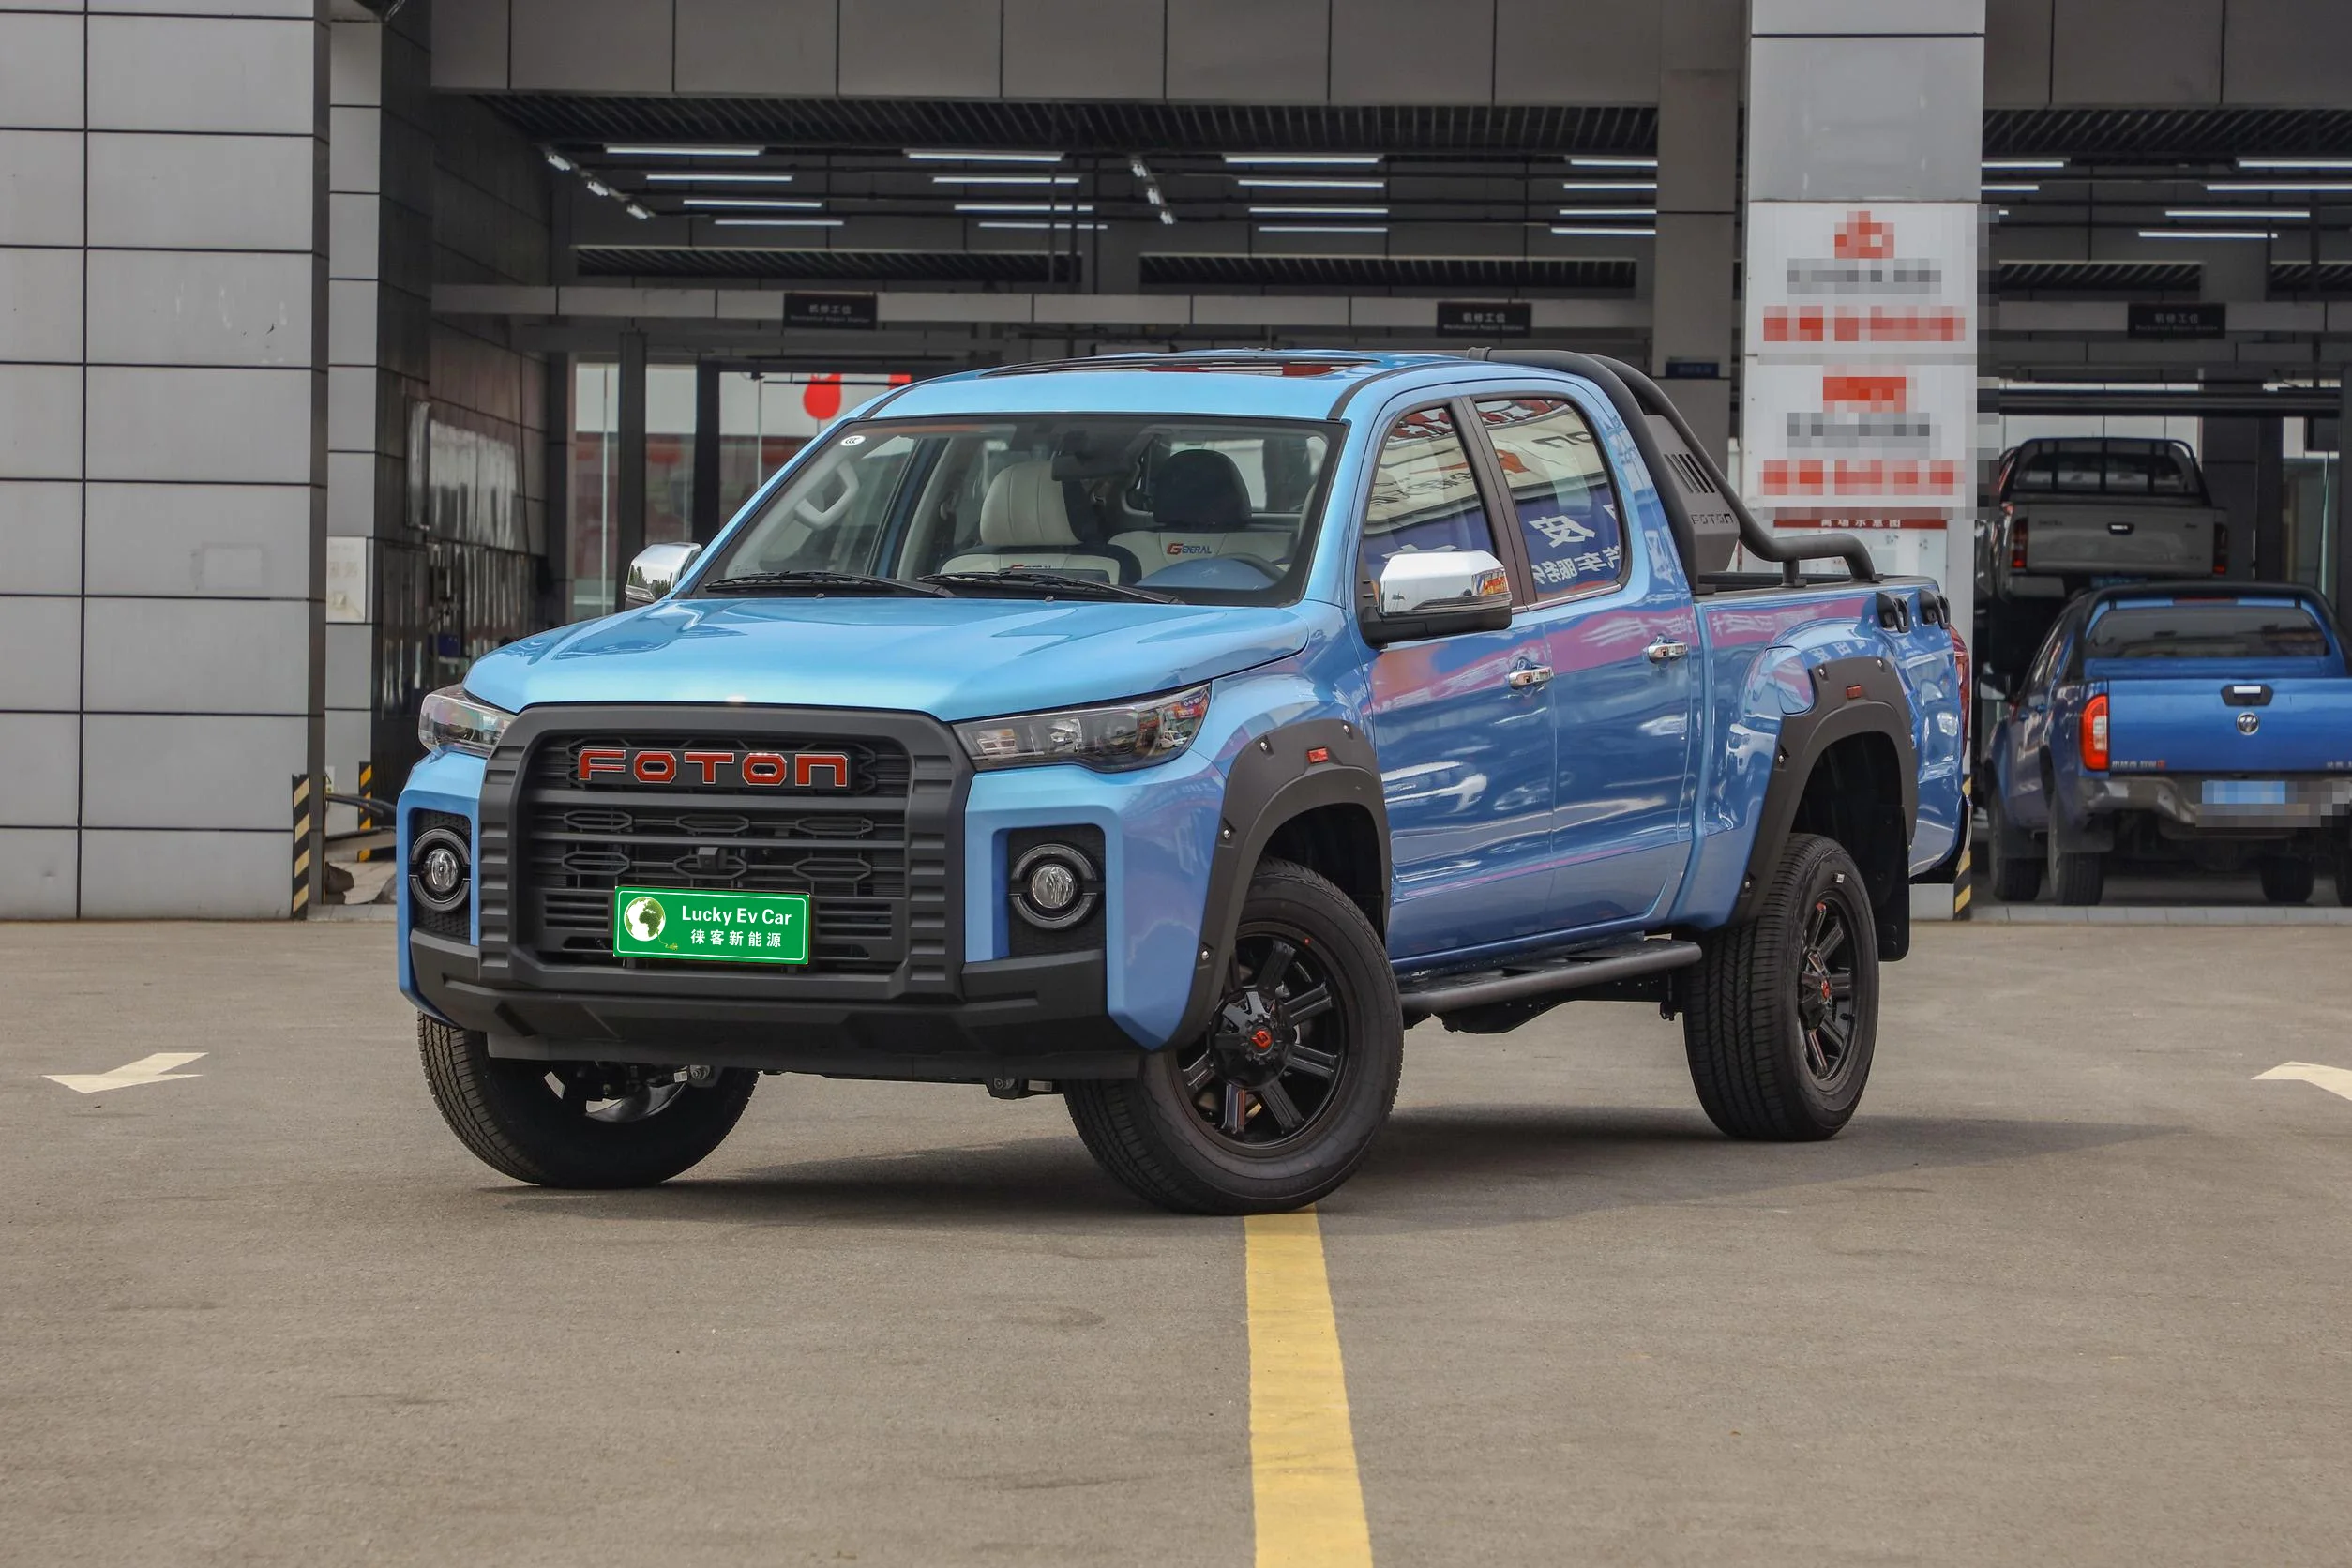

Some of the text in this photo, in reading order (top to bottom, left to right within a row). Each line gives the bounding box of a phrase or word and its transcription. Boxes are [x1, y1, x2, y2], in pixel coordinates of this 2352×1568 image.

[1690, 513, 1734, 525] FOTON
[1167, 543, 1212, 554] GENERAL
[579, 748, 849, 787] FOTON
